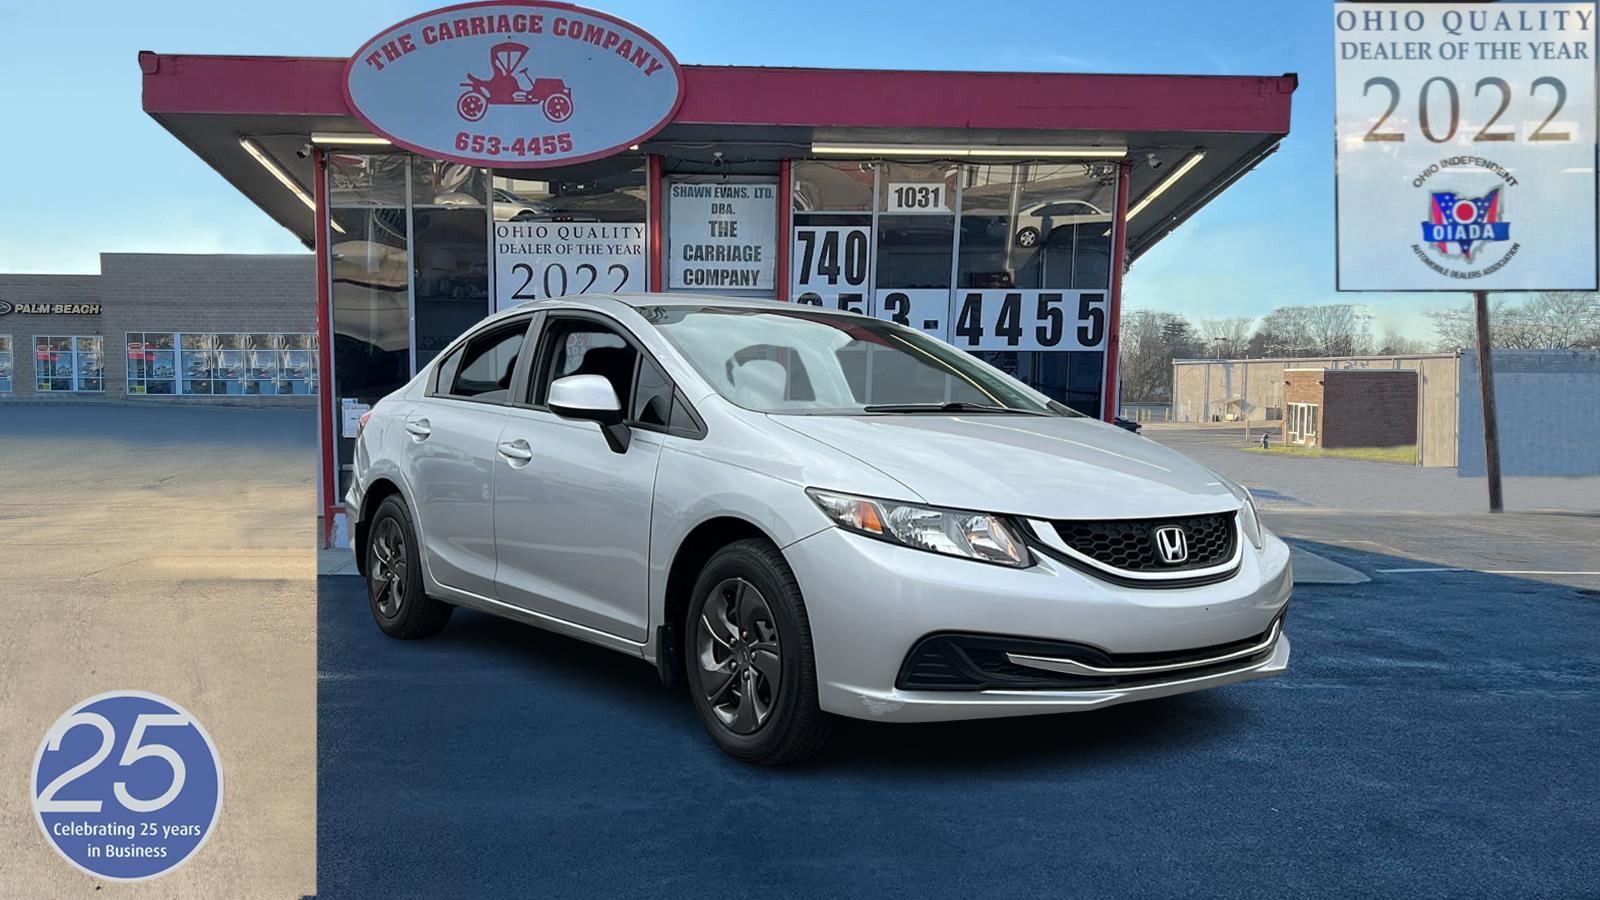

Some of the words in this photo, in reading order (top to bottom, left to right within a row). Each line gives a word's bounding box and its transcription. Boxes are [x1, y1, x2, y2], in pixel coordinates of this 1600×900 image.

[1336, 10, 1425, 31] OHIO
[1442, 10, 1593, 36] QUALITY
[366, 33, 416, 72] THE
[422, 14, 543, 45] CARRIAGE
[553, 17, 664, 77] COMPANY
[1341, 41, 1433, 60] DEALER
[1439, 41, 1469, 60] OF
[1475, 41, 1522, 60] THE
[1528, 41, 1589, 60] YEAR
[1362, 76, 1571, 143] 2022
[455, 132, 573, 157] 653-4455
[1412, 164, 1439, 188] OHIO
[1440, 155, 1519, 187] INDEPENDENT
[673, 186, 711, 198] SHAWN
[754, 188, 774, 199] LTD.
[894, 186, 940, 208] 1031
[711, 203, 736, 215] DBA.
[497, 225, 548, 239] OHIO
[558, 225, 644, 241] QUALITY
[709, 221, 737, 238] THE
[1432, 224, 1495, 240] OIADA
[500, 244, 552, 255] DEALER
[555, 244, 574, 255] OF
[575, 244, 602, 255] THE
[607, 244, 642, 255] YEAR
[683, 244, 762, 262] CARRIAGE
[797, 230, 868, 286] 740
[511, 263, 630, 299] 2022
[683, 268, 760, 286] COMPANY
[15, 303, 50, 313] PALM
[54, 304, 100, 313] BEACH
